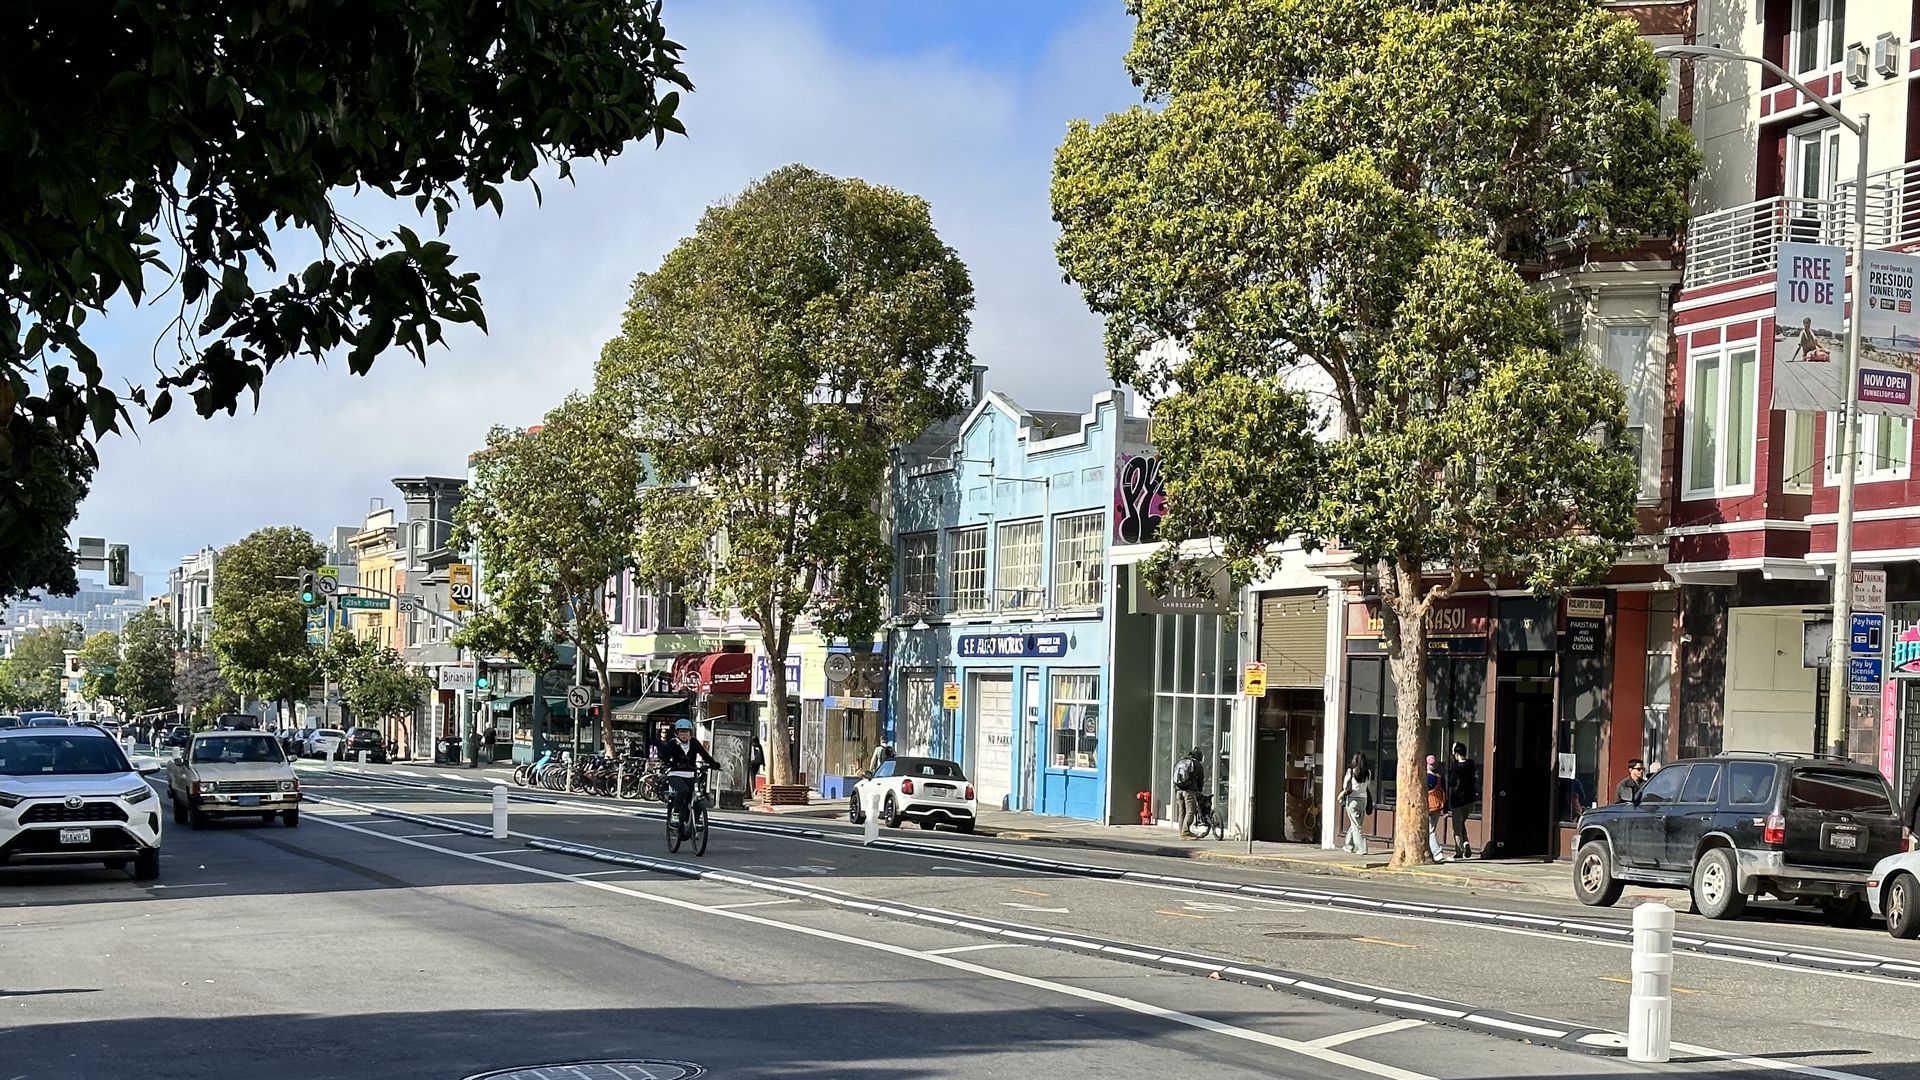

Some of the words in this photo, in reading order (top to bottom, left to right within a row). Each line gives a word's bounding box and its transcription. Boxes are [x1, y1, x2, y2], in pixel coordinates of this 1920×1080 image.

[1793, 256, 1831, 280] FREE
[1870, 271, 1913, 289] PRESIDIO
[1789, 280, 1809, 303] TO
[1815, 282, 1834, 305] BE
[1869, 285, 1894, 297] TUNNEL
[1896, 287, 1912, 299] TOPS
[1863, 373, 1884, 387] NOW
[1886, 376, 1907, 389] OPEN
[1864, 574, 1884, 583] PARKING
[451, 583, 472, 599] 20
[364, 600, 387, 608] Street
[400, 603, 413, 611] 20
[1425, 603, 1466, 630] RASOI
[1570, 621, 1599, 629] PAKISTANI
[1853, 617, 1865, 628] Pay
[1866, 617, 1882, 627] here
[1573, 635, 1594, 643] INDIAN
[998, 636, 1024, 655] WORKS
[1571, 643, 1595, 651] CUISINE
[1851, 660, 1863, 668] Pay
[1864, 660, 1873, 668] by
[443, 671, 466, 682] Biriani
[1851, 683, 1879, 691] 70010005
